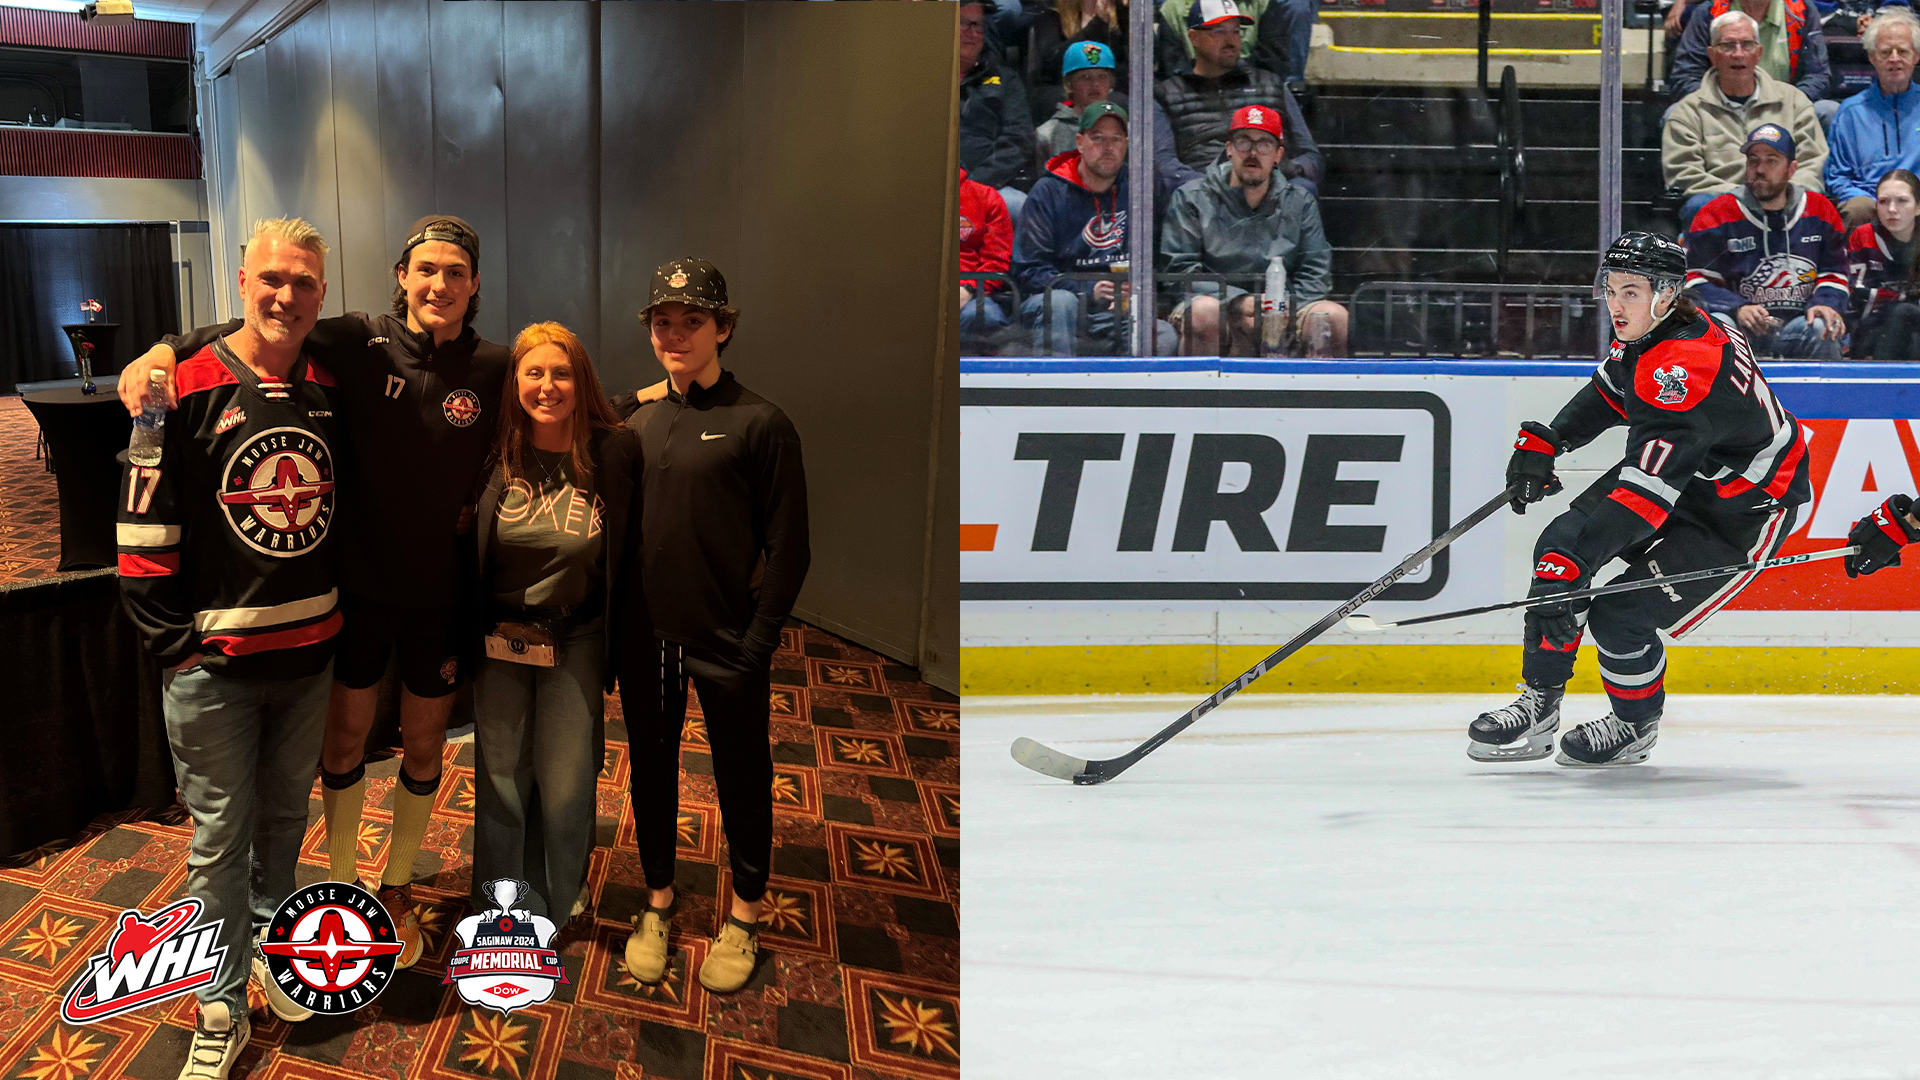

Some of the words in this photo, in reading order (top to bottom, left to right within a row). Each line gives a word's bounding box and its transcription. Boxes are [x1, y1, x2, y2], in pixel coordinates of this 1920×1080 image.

[1800, 235, 1822, 243] CC
[1608, 252, 1630, 260] CCM
[384, 374, 406, 400] 17
[219, 410, 247, 430] WHL
[308, 410, 333, 418] CCM
[241, 435, 287, 468] MOOSE
[298, 438, 323, 461] JAW
[1639, 438, 1675, 476] 17
[126, 465, 163, 515] 17
[1013, 432, 1406, 553] TIRE
[239, 504, 330, 550] WARRIORS
[1535, 561, 1567, 576] CM
[1337, 568, 1406, 620] RIBCOR
[1191, 660, 1267, 722] CCM
